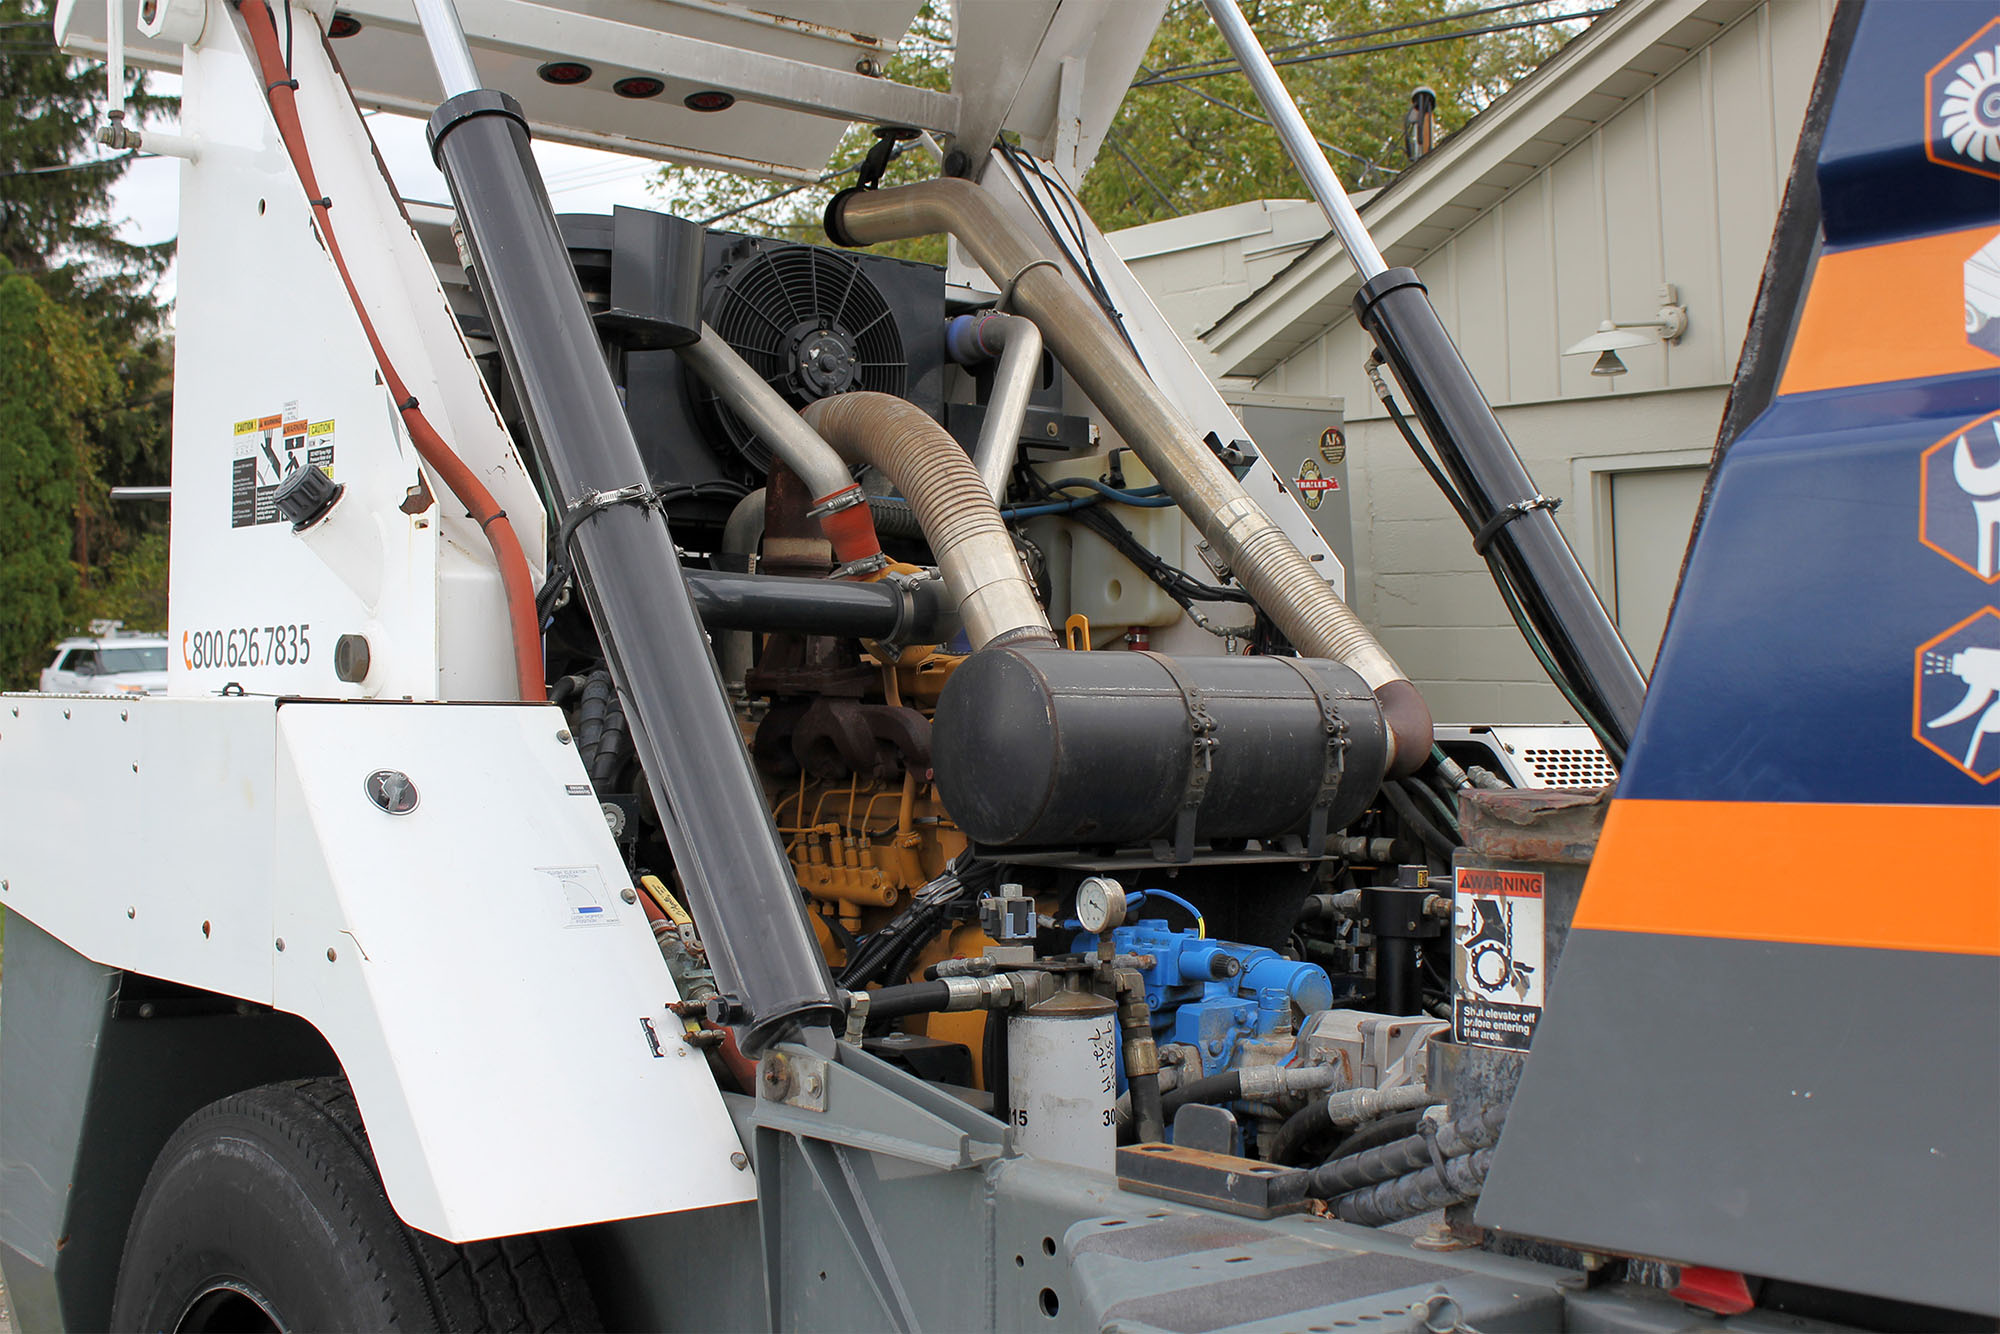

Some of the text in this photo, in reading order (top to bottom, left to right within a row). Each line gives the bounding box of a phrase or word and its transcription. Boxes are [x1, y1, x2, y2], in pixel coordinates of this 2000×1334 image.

[236, 422, 253, 433] CAUTION
[311, 423, 330, 434] CAUTION
[192, 623, 310, 669] 800.626.7835
[1471, 874, 1542, 893] WARNING
[1485, 1008, 1521, 1021] elevator
[1522, 1012, 1536, 1024] off
[1493, 1020, 1530, 1036] entering
[1012, 1108, 1028, 1127] 15
[1102, 1108, 1116, 1127] 30
